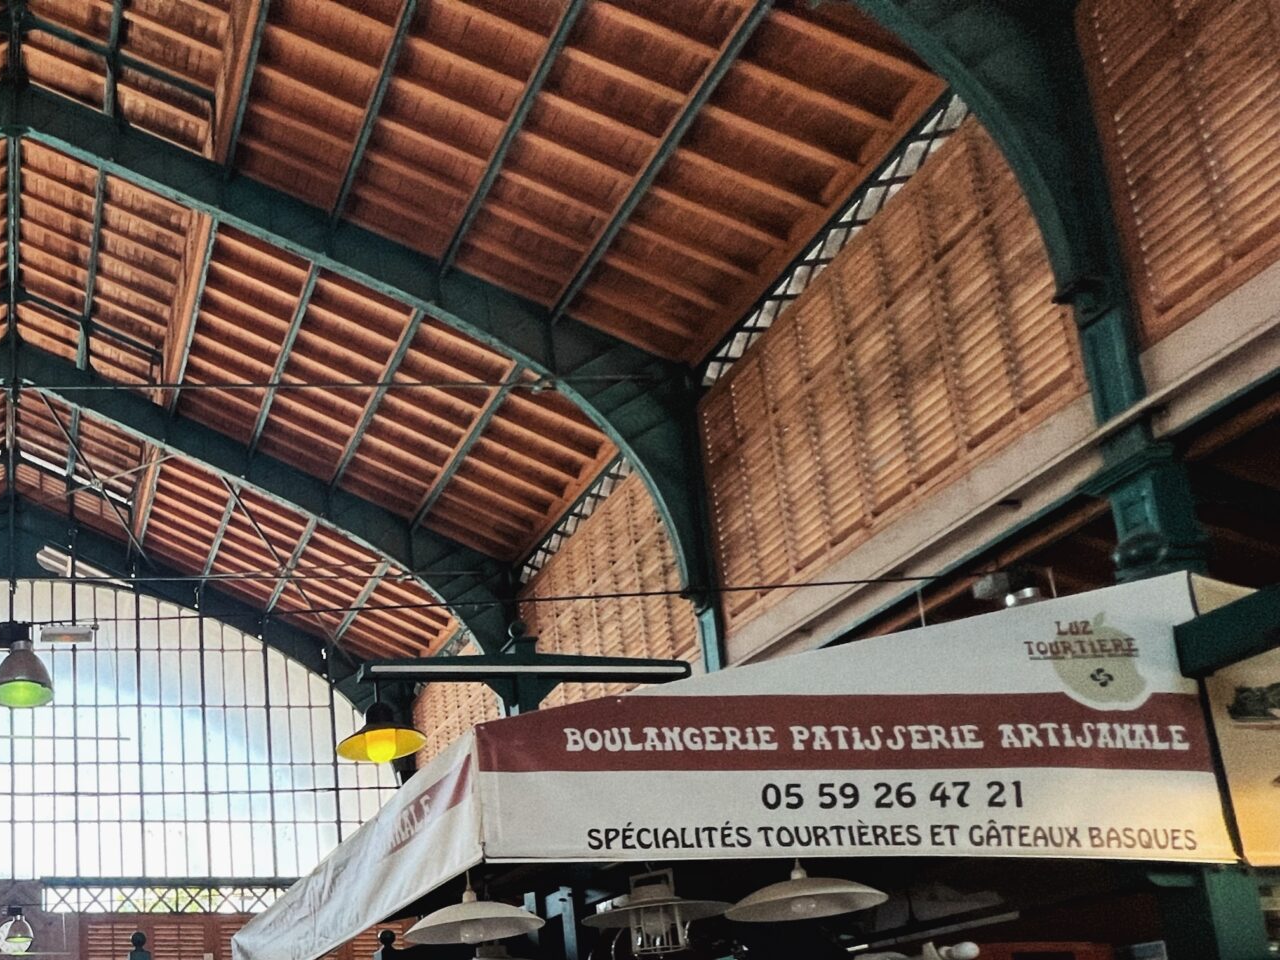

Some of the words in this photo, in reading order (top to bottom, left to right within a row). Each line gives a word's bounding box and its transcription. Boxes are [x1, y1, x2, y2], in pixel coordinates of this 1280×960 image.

[761, 783, 804, 810] 05
[818, 783, 860, 809] 59
[874, 782, 916, 808] 26
[930, 781, 971, 808] 47
[987, 780, 1024, 808] 21
[588, 821, 752, 850] SPÉCIALITÉS
[757, 819, 921, 848] TOURTIÈRES
[930, 824, 959, 846] ET
[969, 820, 1082, 848] GÂTEAUX
[1088, 826, 1197, 850] BASQUES
